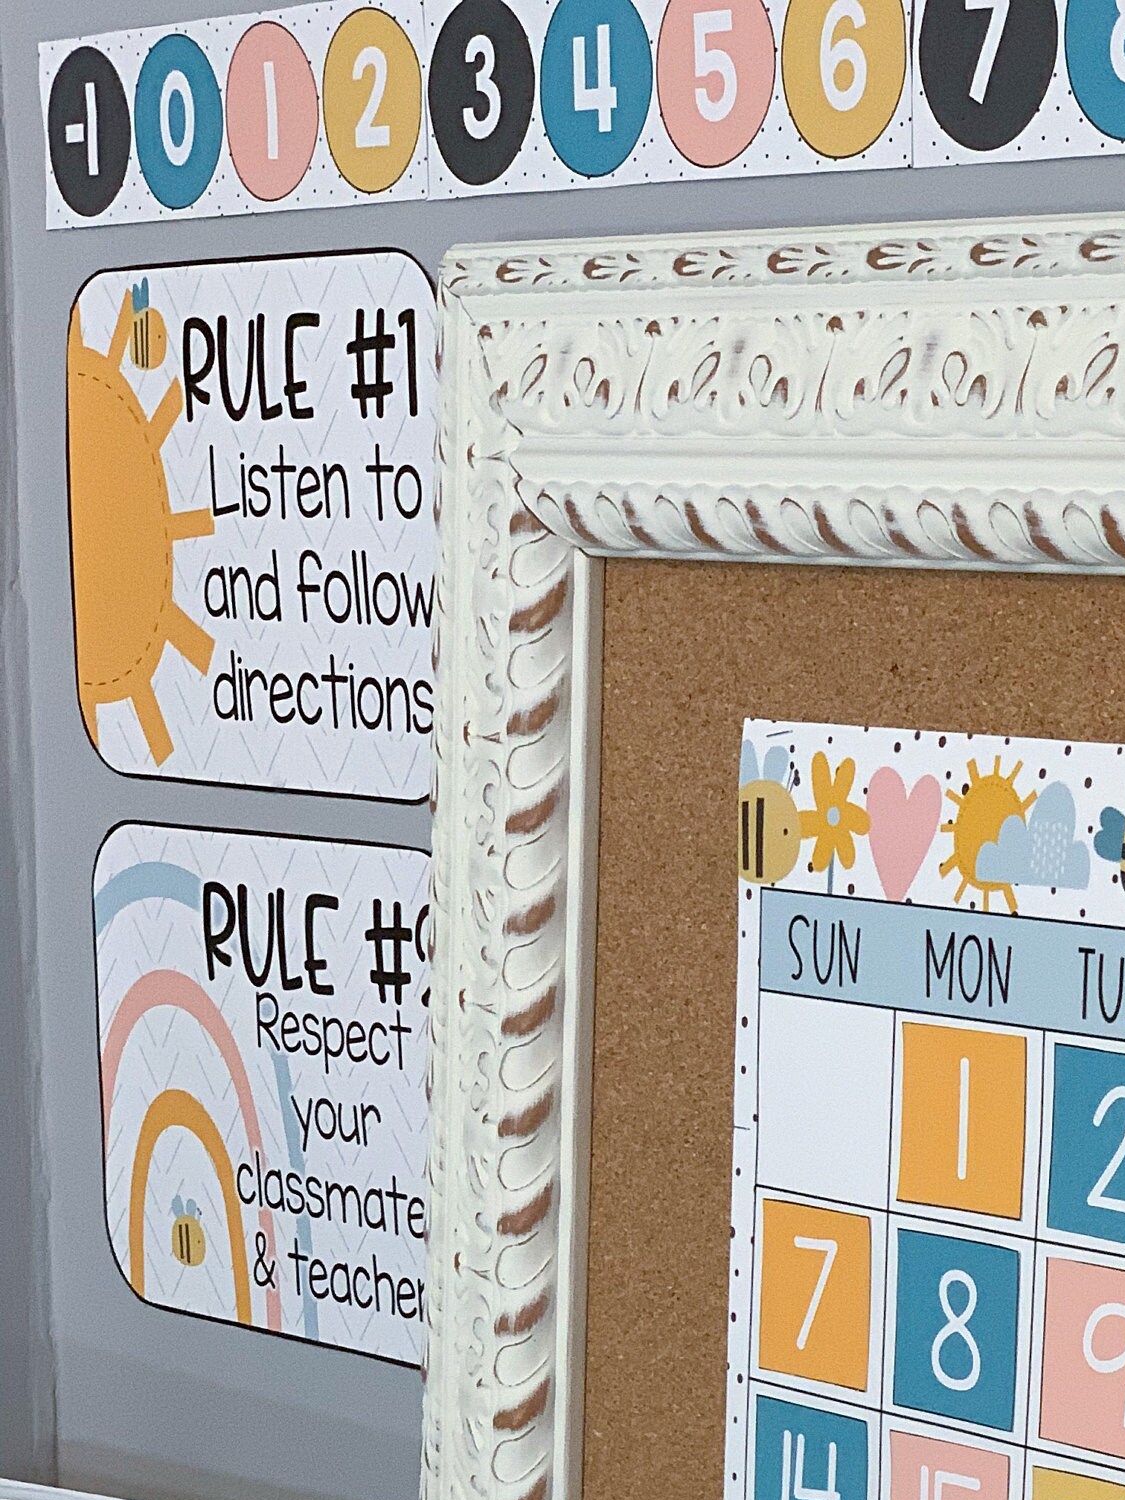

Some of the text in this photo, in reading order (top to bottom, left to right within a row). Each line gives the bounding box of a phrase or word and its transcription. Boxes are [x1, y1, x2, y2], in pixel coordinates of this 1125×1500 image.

[66, 82, 98, 175] -1
[160, 70, 194, 166] 0
[263, 61, 278, 159] 1
[353, 46, 390, 148] 2
[463, 35, 501, 139] 3
[573, 24, 617, 132] 4
[693, 9, 737, 122] 5
[820, 0, 867, 111] 6
[965, 0, 1009, 104] 7
[183, 308, 417, 422] RULE #1
[210, 444, 422, 521] Listen to
[205, 550, 435, 627] and follow
[213, 650, 434, 734] directions
[202, 881, 339, 996] RULE
[789, 915, 860, 987] SUN
[926, 929, 1012, 1007] MON
[255, 991, 412, 1074] Respect
[291, 1096, 381, 1152] your
[958, 1058, 969, 1179] 1
[236, 1151, 425, 1239] classmate
[254, 1232, 275, 1289] &
[794, 1236, 837, 1349] 7
[932, 1270, 980, 1390] 8
